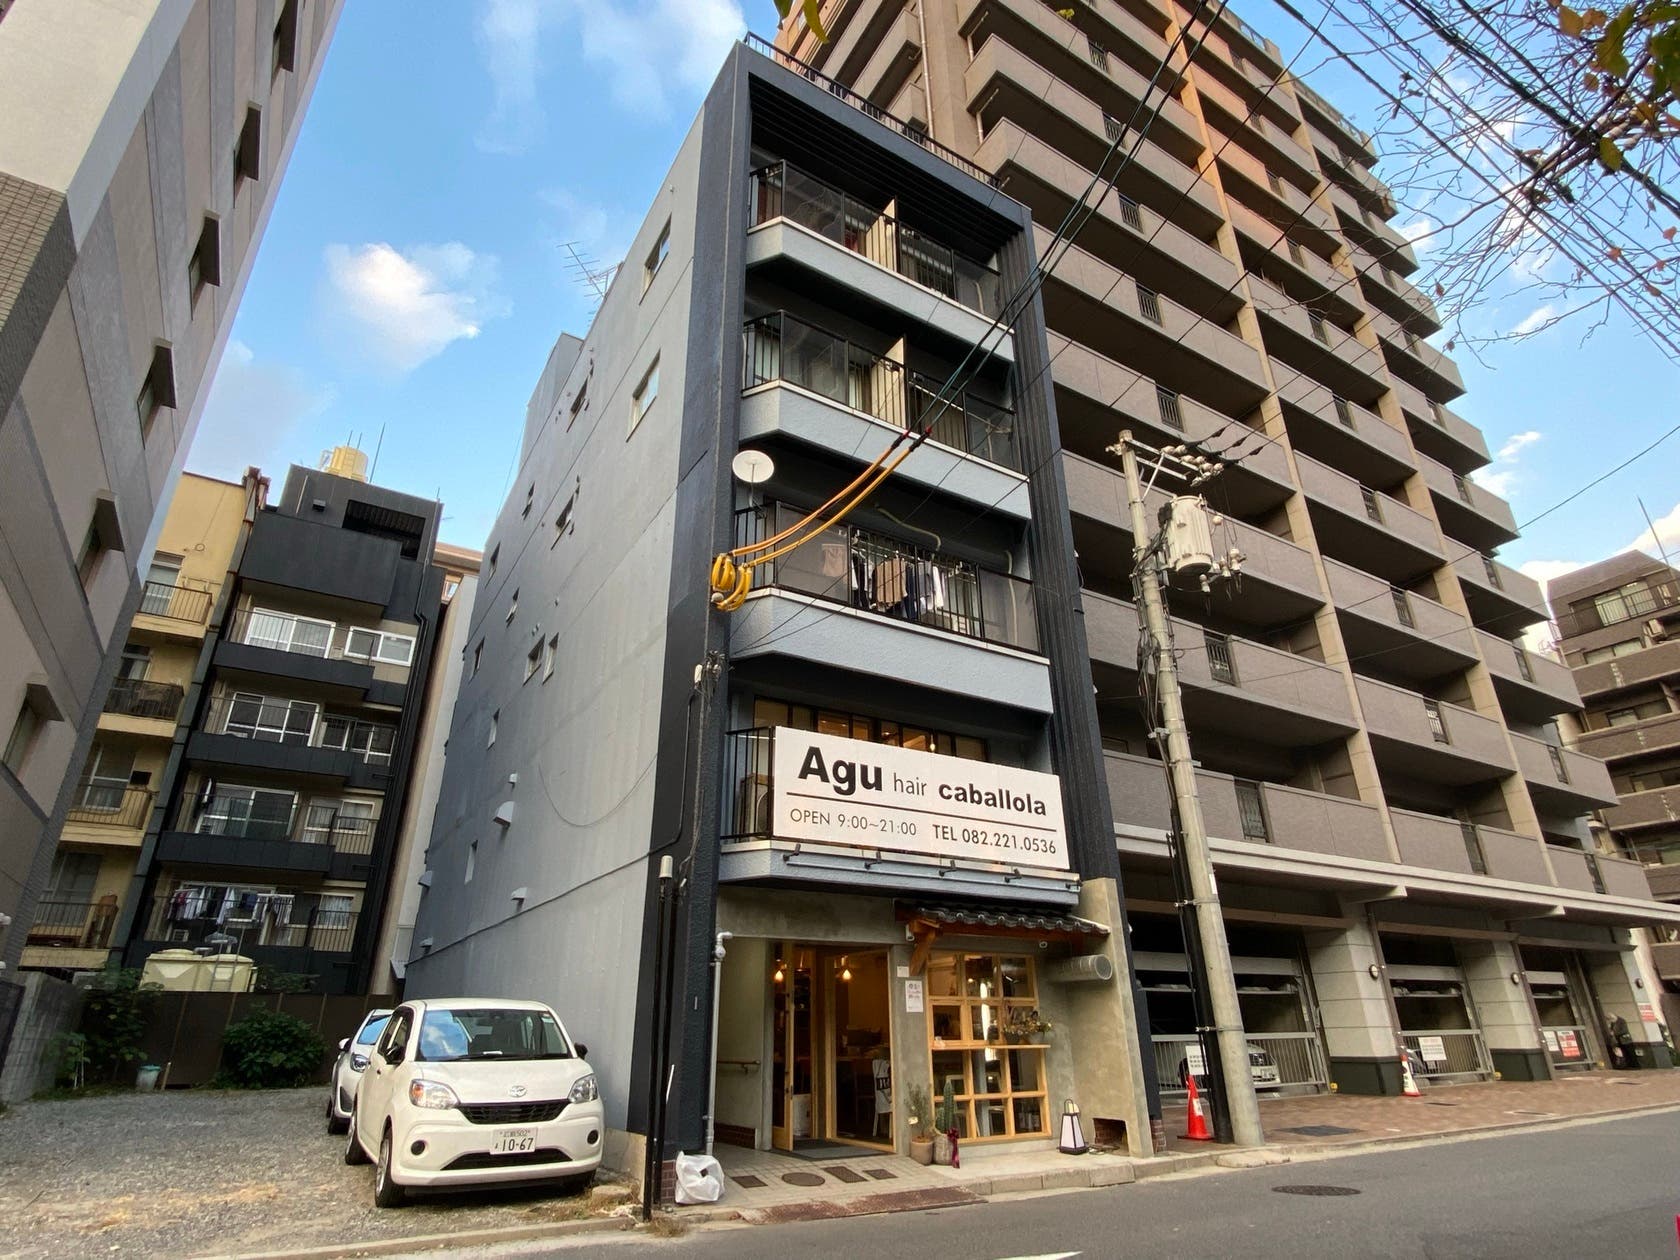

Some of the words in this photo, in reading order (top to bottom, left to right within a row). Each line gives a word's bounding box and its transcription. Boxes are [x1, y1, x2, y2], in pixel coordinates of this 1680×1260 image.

[798, 746, 883, 796] Agu
[893, 772, 927, 797] hair
[938, 782, 1047, 816] caballola
[790, 808, 830, 826] OPEN
[932, 824, 958, 842] TEL
[962, 827, 1056, 855] 082.221.0536
[502, 1138, 534, 1151] 10-67
